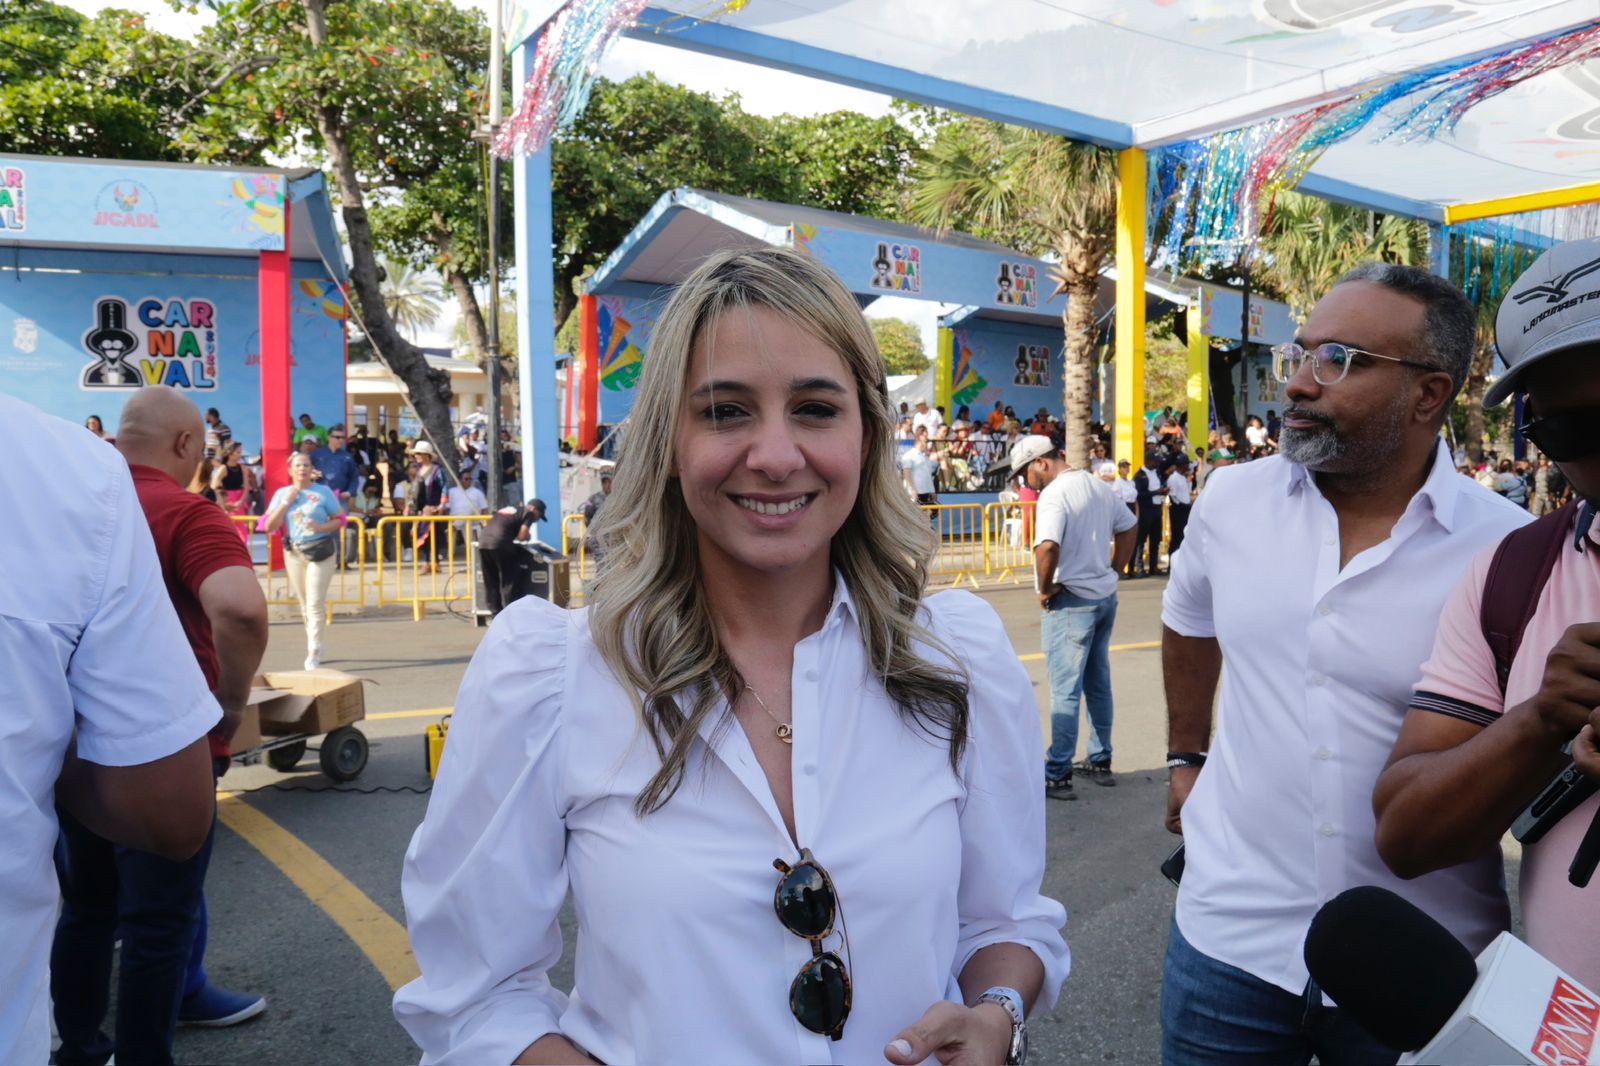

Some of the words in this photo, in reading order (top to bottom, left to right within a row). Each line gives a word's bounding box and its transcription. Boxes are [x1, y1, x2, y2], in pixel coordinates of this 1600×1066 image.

[138, 300, 214, 328] CAR
[148, 330, 202, 357] NA
[139, 359, 214, 388] VAL
